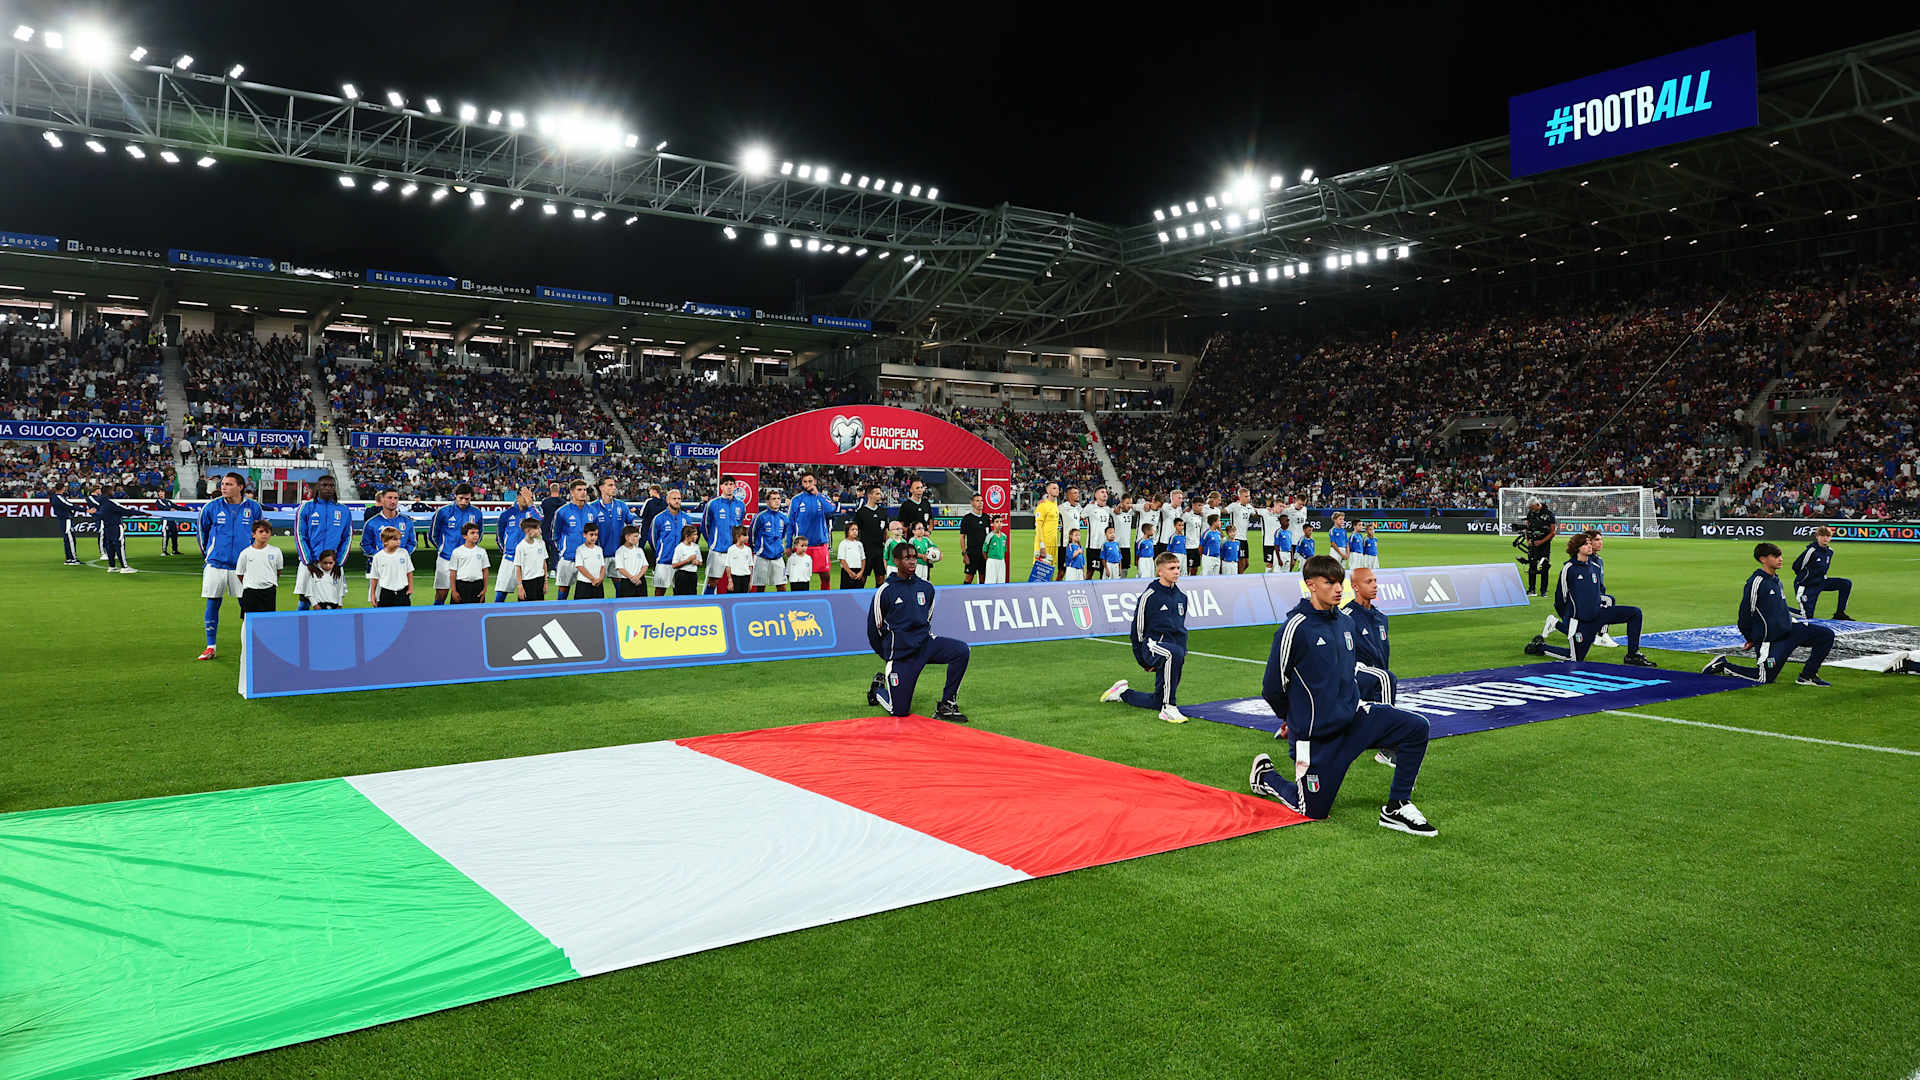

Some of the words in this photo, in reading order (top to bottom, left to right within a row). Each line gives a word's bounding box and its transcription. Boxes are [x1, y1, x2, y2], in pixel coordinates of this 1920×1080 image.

[1544, 69, 1713, 147] #FOOTBALL
[67, 239, 160, 258] Rinascimento
[179, 252, 264, 269] Rinascimento
[19, 425, 77, 437] GIUOCO
[83, 427, 134, 439] CALCIO
[213, 432, 245, 442] IALIA
[870, 426, 919, 438] EUROPEAN
[455, 439, 500, 450] ITALIANA
[863, 437, 925, 451] QUALIFIERS
[1418, 521, 1442, 530] children
[1560, 523, 1630, 533] FOUNDATION
[1793, 525, 1818, 537] UEF
[1377, 583, 1406, 601] TIM
[964, 597, 1064, 632] ITALIA
[1102, 589, 1223, 623] ESNIA
[640, 623, 718, 641] Telepass
[748, 613, 787, 638] eni
